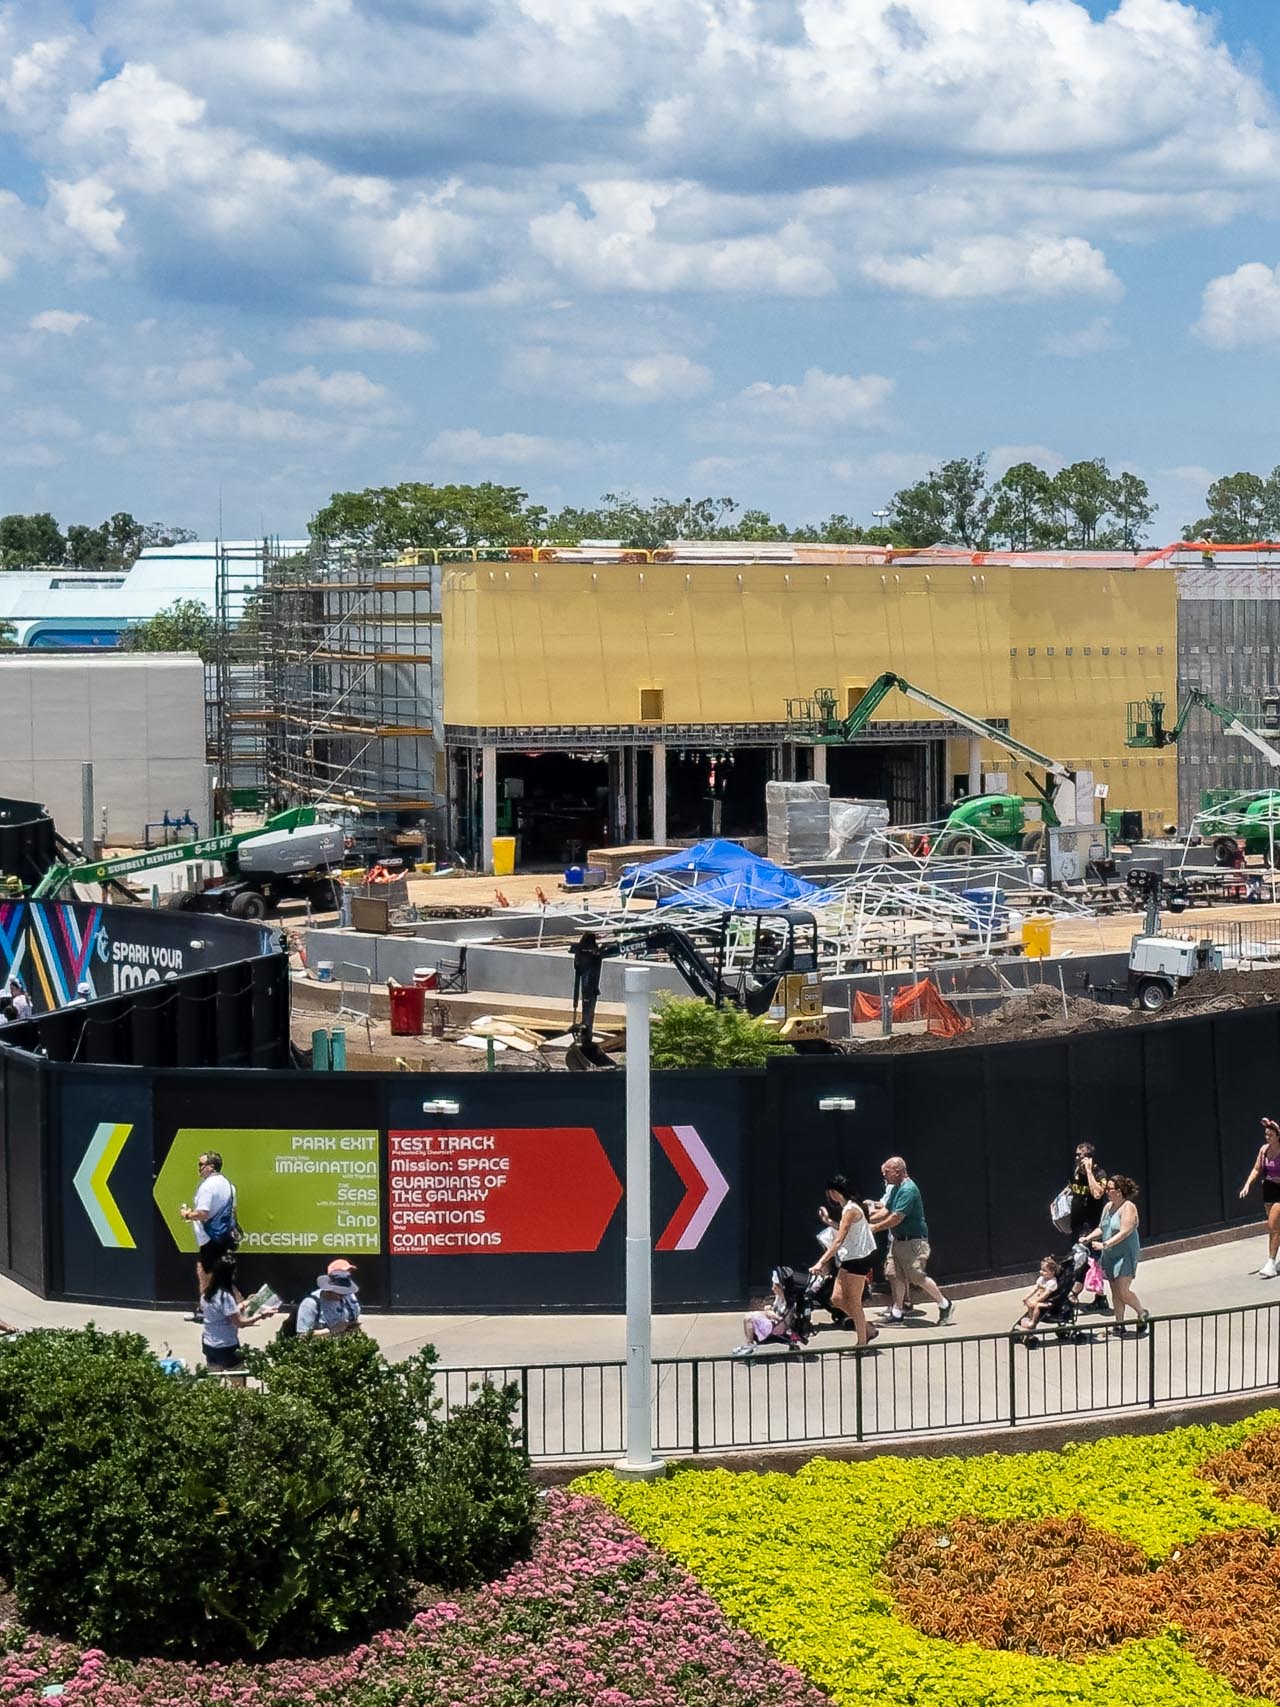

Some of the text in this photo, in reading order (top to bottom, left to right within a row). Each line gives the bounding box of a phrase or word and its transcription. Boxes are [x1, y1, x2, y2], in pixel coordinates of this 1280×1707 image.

[112, 941, 183, 969] SPARK YOUR
[291, 1136, 376, 1150] PARK EXIT
[391, 1136, 495, 1150] TEST TRACK
[275, 1160, 377, 1173] IMAGINATION
[391, 1158, 510, 1172] Mission: SPACE
[391, 1175, 507, 1189] GUARDIANS OF
[337, 1188, 377, 1200] SEAS
[392, 1188, 489, 1203] THE GALAXY
[337, 1215, 377, 1227] LAND
[392, 1210, 486, 1224] CREATIONS
[322, 1232, 379, 1247] EARTH
[392, 1232, 502, 1246] CONNECTIONS
